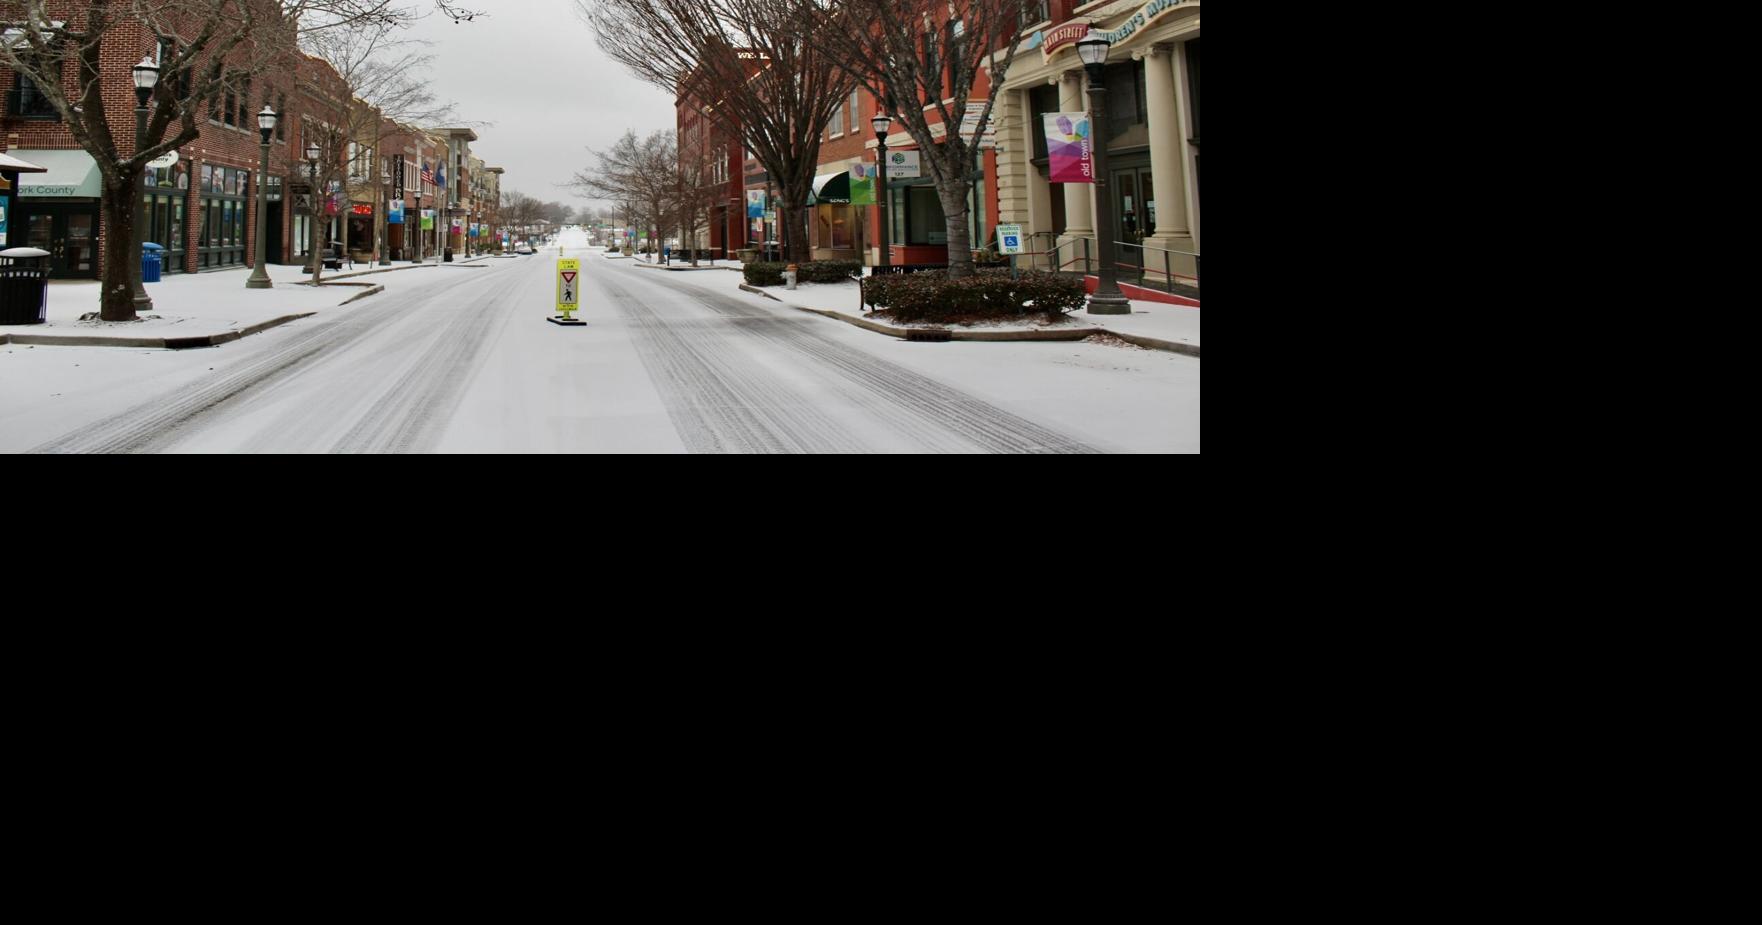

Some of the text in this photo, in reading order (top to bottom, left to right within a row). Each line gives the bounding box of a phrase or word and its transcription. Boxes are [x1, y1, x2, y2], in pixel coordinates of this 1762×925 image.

[1059, 27, 1084, 40] STREET
[1080, 140, 1090, 176] old town
[17, 186, 76, 195] ork County
